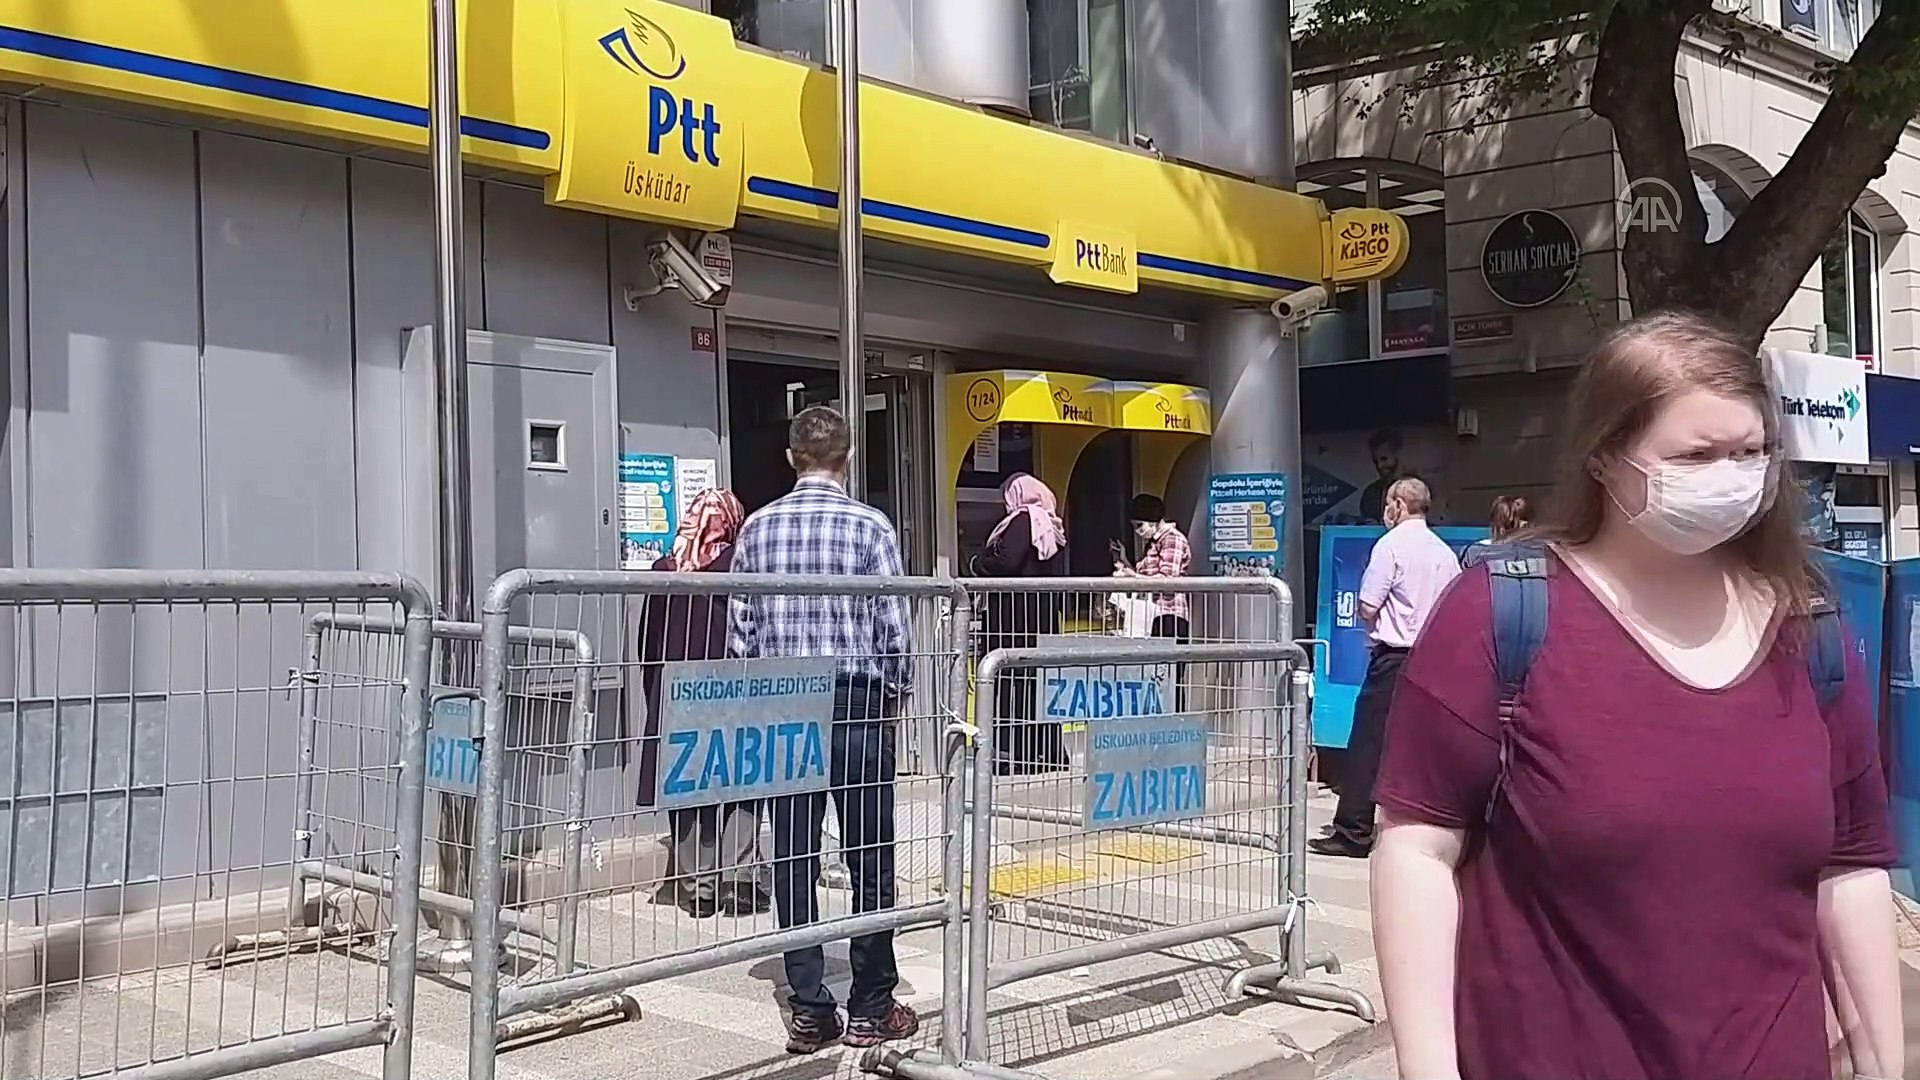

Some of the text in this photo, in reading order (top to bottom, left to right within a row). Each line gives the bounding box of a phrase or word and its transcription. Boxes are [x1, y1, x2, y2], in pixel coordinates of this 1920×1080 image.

[648, 85, 720, 167] Ptt
[624, 161, 691, 204] Üsküdar
[1371, 222, 1389, 237] Ptt
[1341, 237, 1389, 260] KARGO
[1488, 241, 1570, 274] SERHAN SOYCAN
[697, 333, 710, 346] 86
[972, 391, 994, 408] 7/24
[1780, 395, 1845, 420] Türk Telekom
[670, 670, 832, 701] ÜSKÜDAR BELEDİYESİ
[1047, 678, 1163, 718] ZABITA
[663, 721, 825, 795] ZABITA
[1092, 765, 1201, 821] ZABITA
